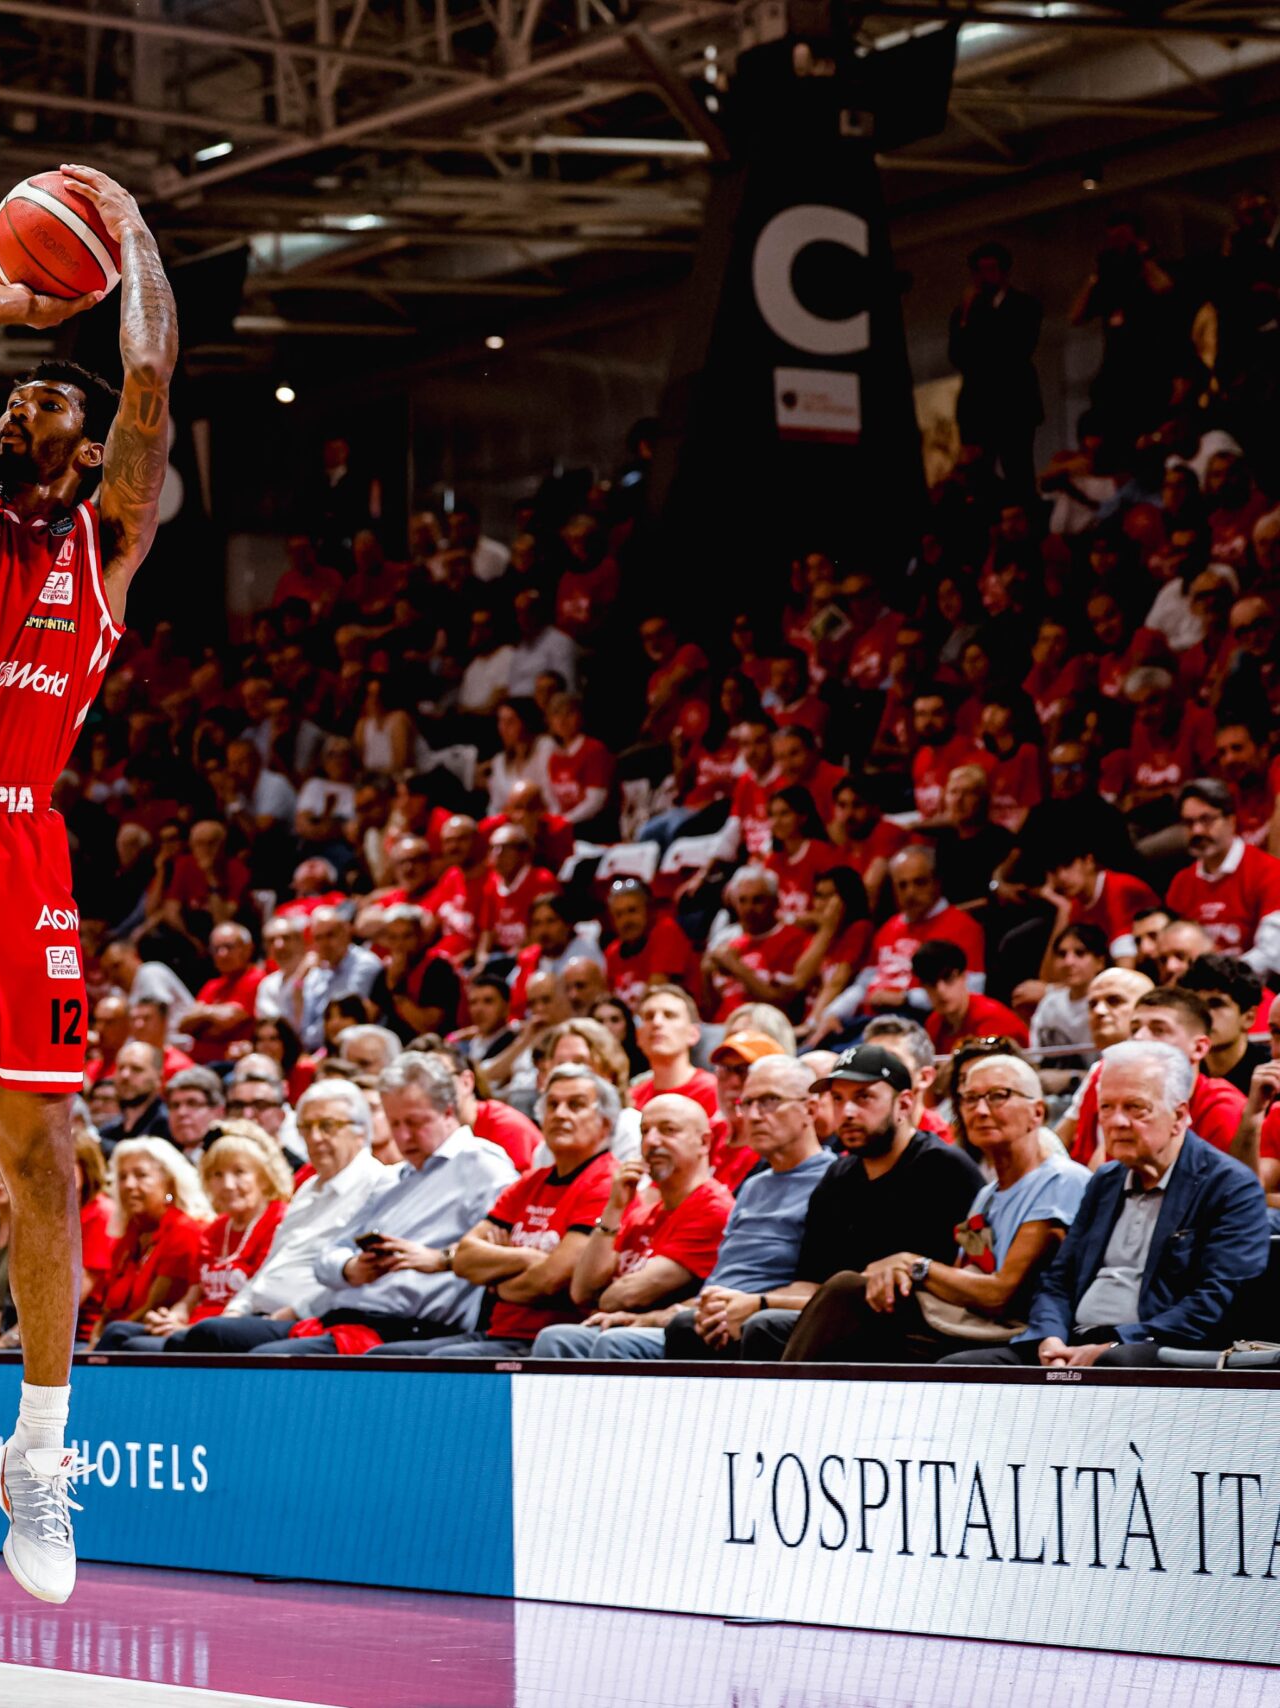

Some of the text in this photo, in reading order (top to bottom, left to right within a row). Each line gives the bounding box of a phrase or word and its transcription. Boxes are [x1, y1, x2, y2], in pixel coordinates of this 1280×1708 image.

[752, 204, 869, 355] C
[34, 904, 79, 931] AON
[50, 998, 82, 1045] 12
[72, 1440, 208, 1493] HOTELS
[723, 1441, 1167, 1573] L’OSPITALITÀ
